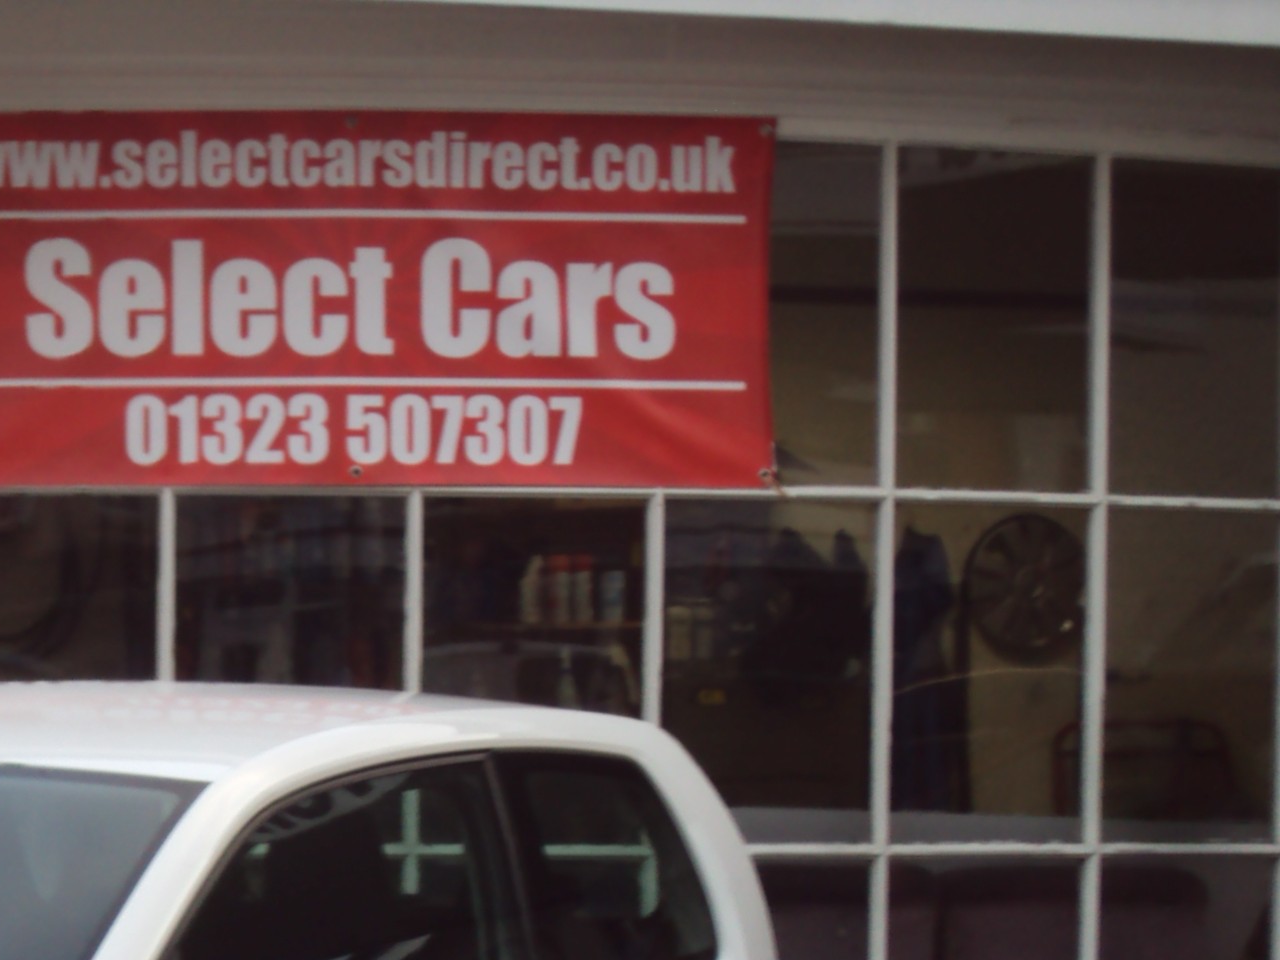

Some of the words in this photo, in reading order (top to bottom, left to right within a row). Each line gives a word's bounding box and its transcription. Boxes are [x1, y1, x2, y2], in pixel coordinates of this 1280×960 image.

[23, 236, 397, 361] Select
[419, 236, 677, 362] Cars
[124, 393, 331, 467] 01323
[344, 395, 584, 469] 507307
